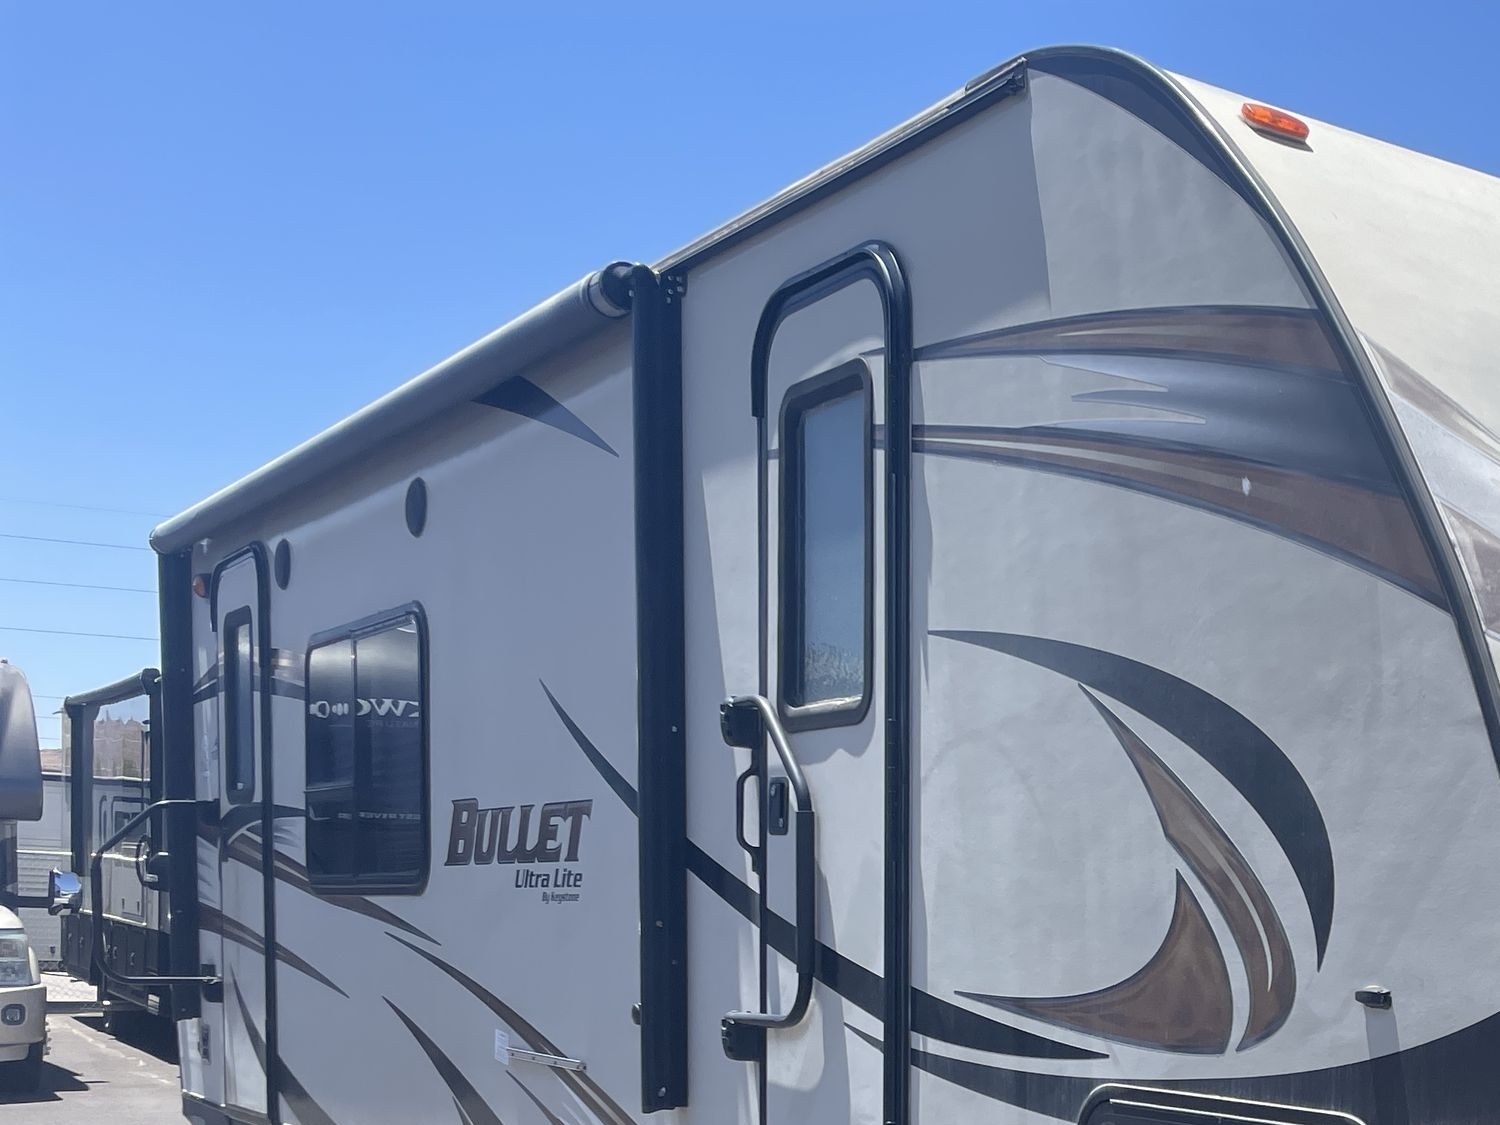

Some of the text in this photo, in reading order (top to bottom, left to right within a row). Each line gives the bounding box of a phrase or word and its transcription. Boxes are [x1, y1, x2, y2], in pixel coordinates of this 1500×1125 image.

[444, 798, 593, 866] BULLET
[515, 868, 583, 888] Ultra Lite
